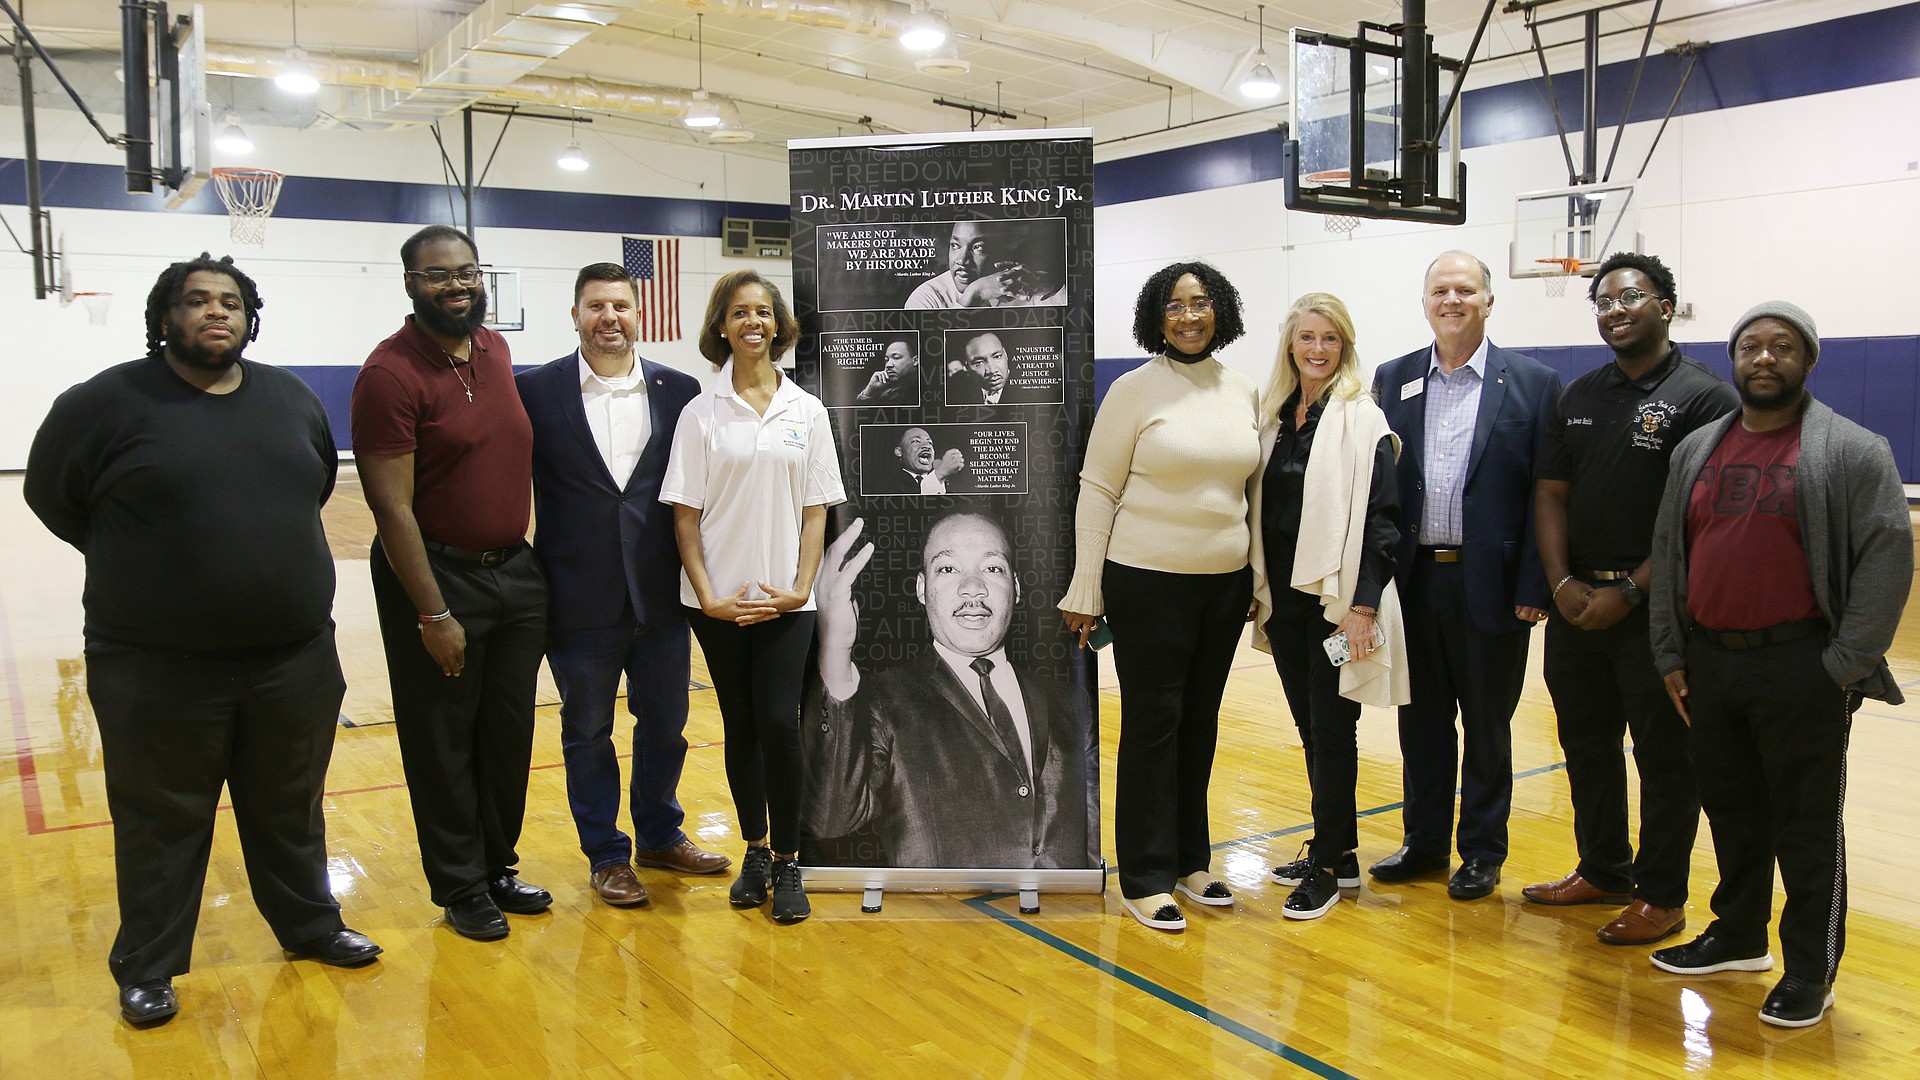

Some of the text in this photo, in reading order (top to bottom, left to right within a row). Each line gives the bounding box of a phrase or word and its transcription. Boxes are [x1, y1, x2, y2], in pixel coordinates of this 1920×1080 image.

[791, 149, 901, 166] EDUCATION
[904, 147, 965, 160] STRUGGLE
[969, 140, 1082, 158] EDUCATION
[829, 159, 968, 186] FREEDOM
[827, 229, 897, 240] "WE ARE NOT
[826, 238, 936, 250] MAKERS OF HISTORY
[762, 248, 780, 256] period
[848, 247, 936, 260] WE ARE MADE
[846, 259, 929, 271] BY HISTORY."
[822, 309, 972, 332] DARKNESS
[822, 343, 885, 353] ALWAYS RIGHT
[837, 357, 869, 366] RIGHT."
[1011, 354, 1051, 362] ANYWHERE
[1009, 377, 1062, 385] EVERYWHERE."
[854, 406, 941, 428] FAITH
[979, 452, 1010, 460] BECOME
[969, 460, 995, 468] SILENT
[971, 467, 998, 475] THINGS
